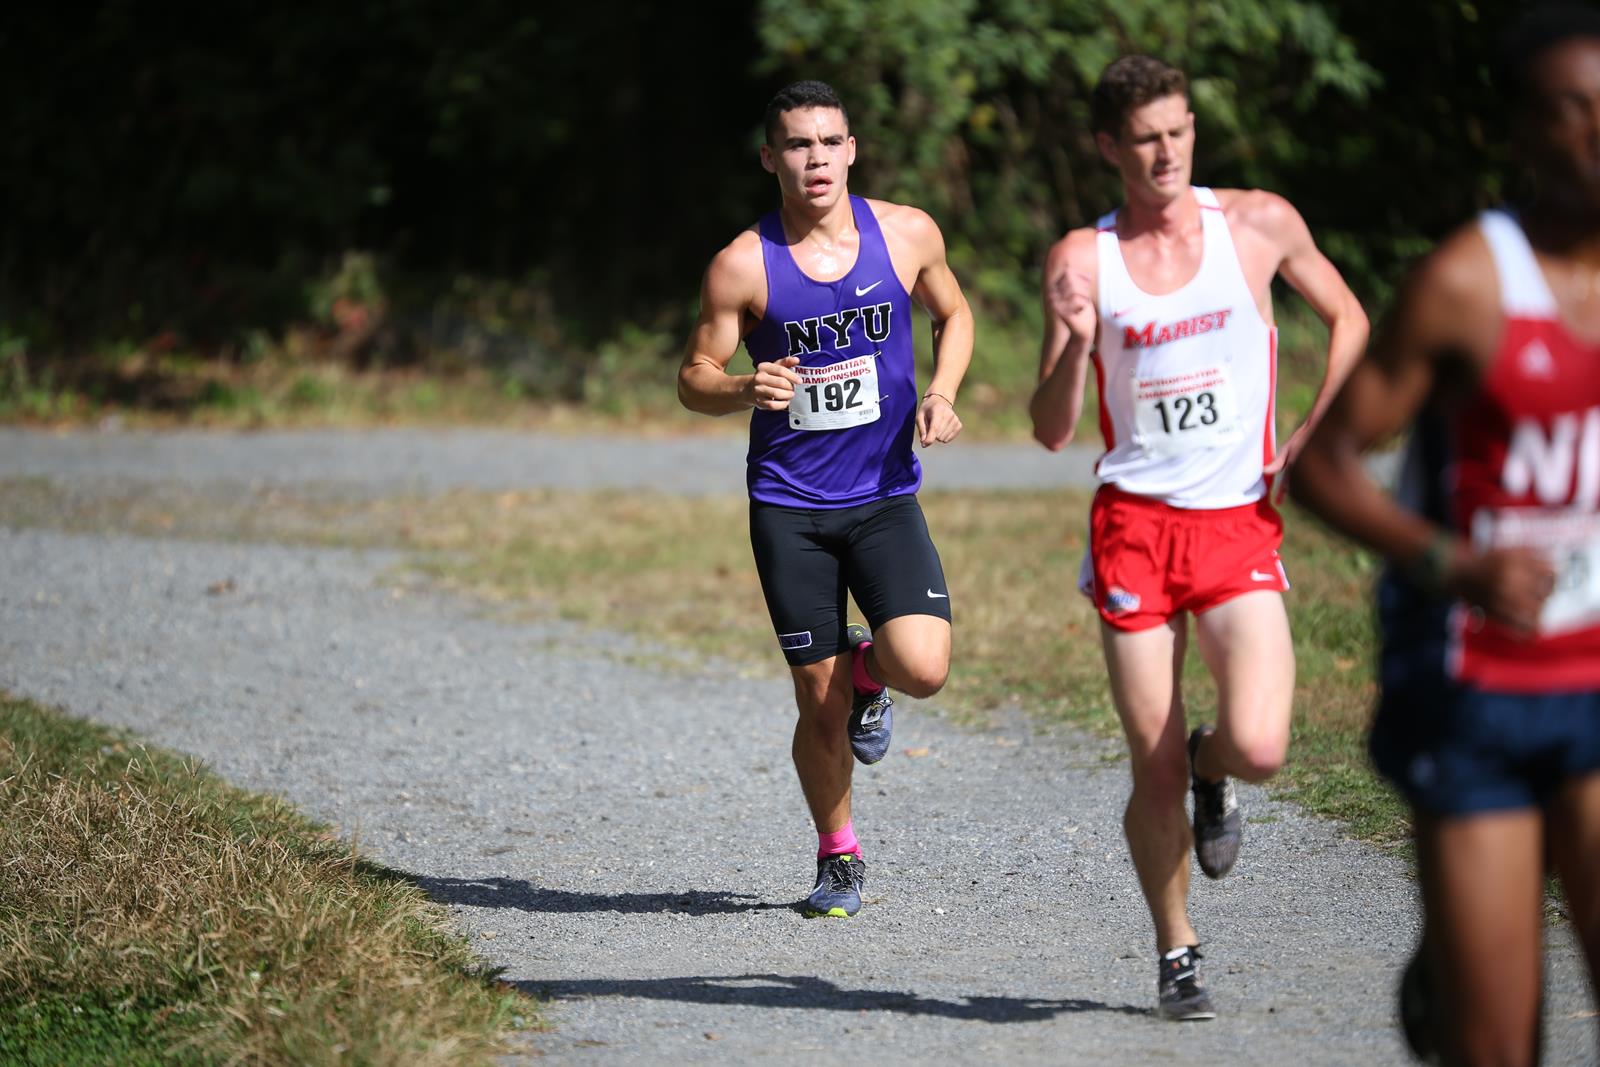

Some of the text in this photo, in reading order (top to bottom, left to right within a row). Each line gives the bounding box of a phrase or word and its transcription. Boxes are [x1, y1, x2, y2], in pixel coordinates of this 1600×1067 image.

[784, 301, 892, 357] NYU
[1122, 308, 1232, 349] MARIST
[795, 359, 867, 375] METROPOLITAN
[801, 367, 871, 384] AMPIONSHIPS
[804, 378, 863, 413] 192
[1154, 392, 1218, 434] 123
